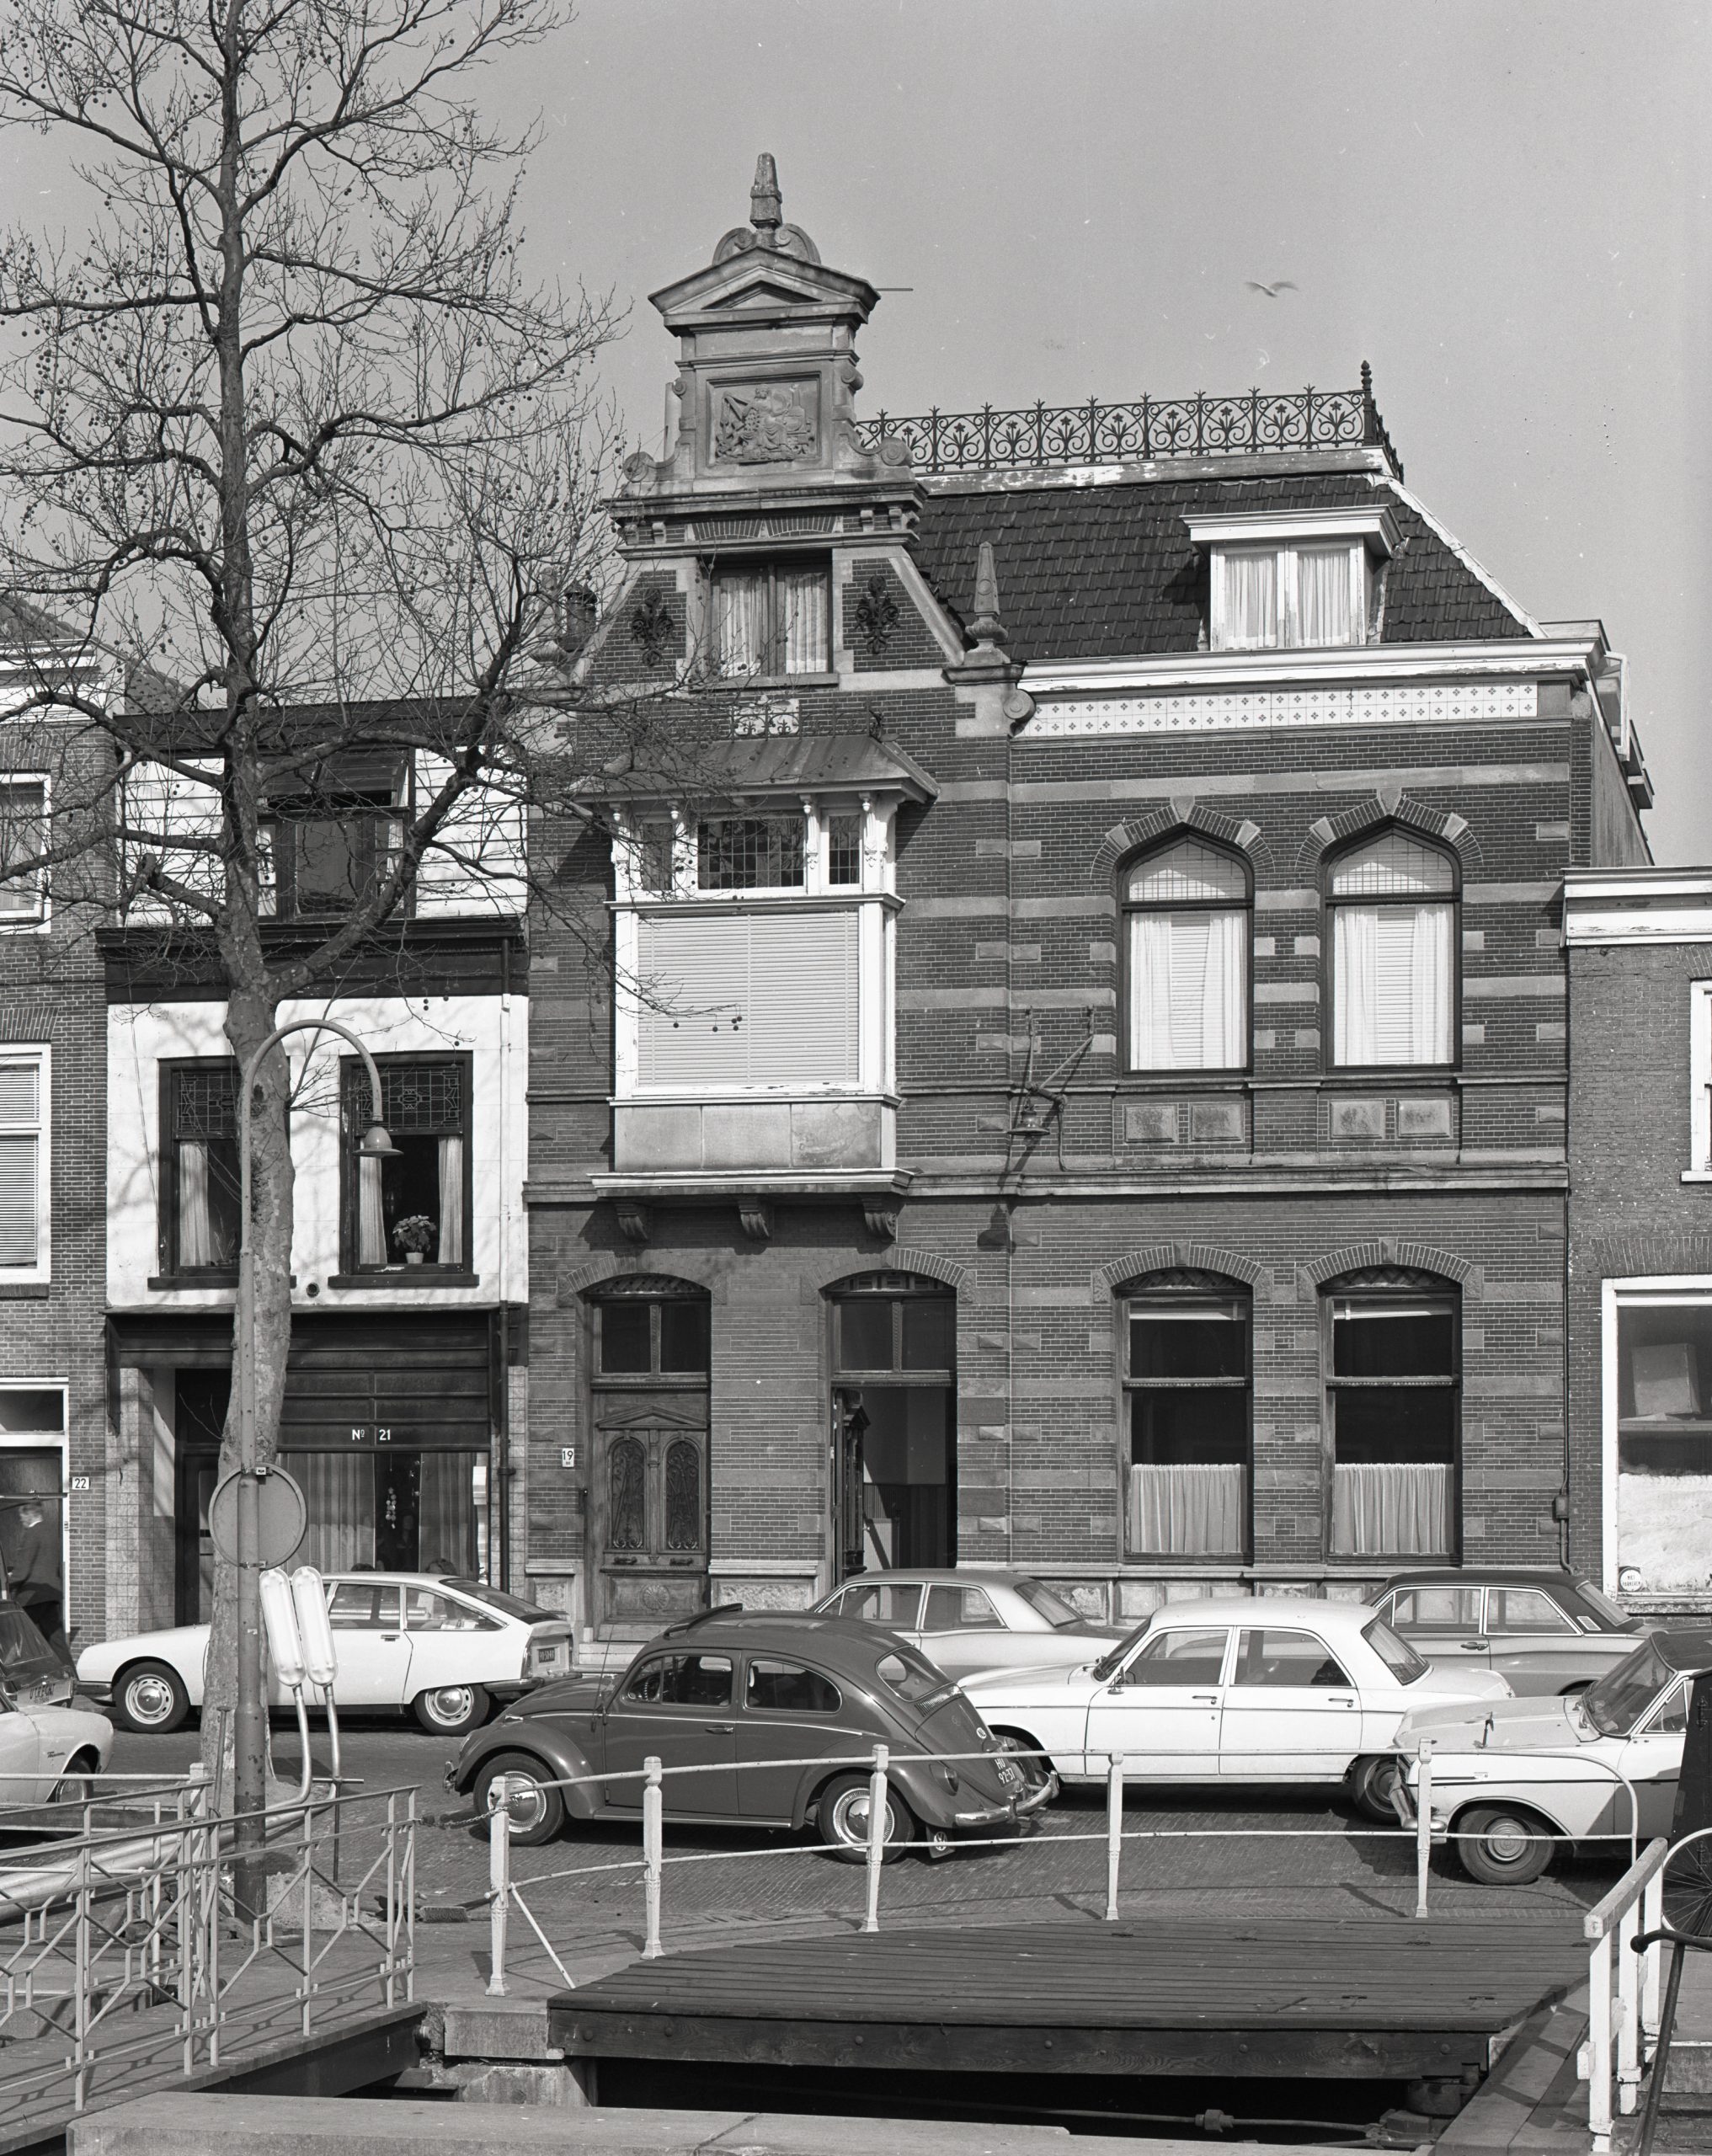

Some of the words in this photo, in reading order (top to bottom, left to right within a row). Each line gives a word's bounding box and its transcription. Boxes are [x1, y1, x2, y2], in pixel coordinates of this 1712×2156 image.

[379, 1428, 391, 1441] 21
[563, 1450, 573, 1460] 19
[74, 1478, 87, 1489] 22
[998, 1768, 1015, 1785] 92-37
